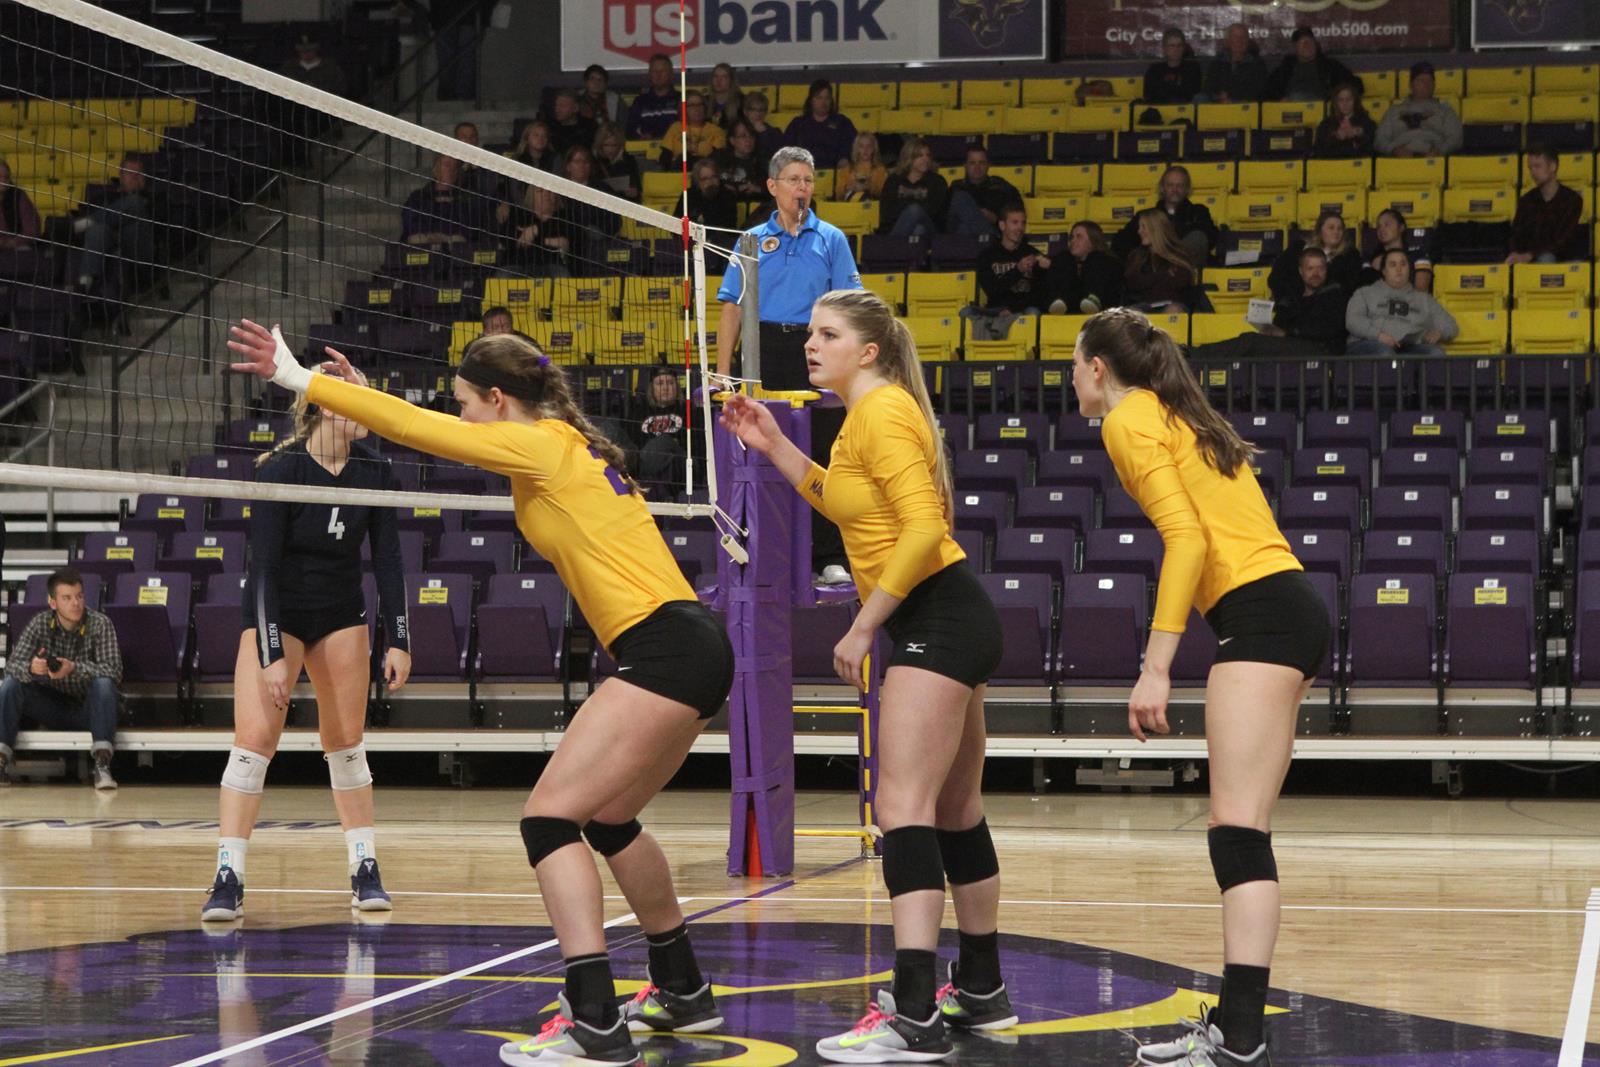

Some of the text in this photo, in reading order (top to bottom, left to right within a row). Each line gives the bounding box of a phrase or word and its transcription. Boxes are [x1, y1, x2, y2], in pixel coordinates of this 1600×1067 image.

[704, 0, 888, 45] bank
[1105, 28, 1136, 45] City
[327, 507, 345, 540] 4
[269, 623, 280, 648] GOLDEN
[396, 616, 406, 639] BEARS
